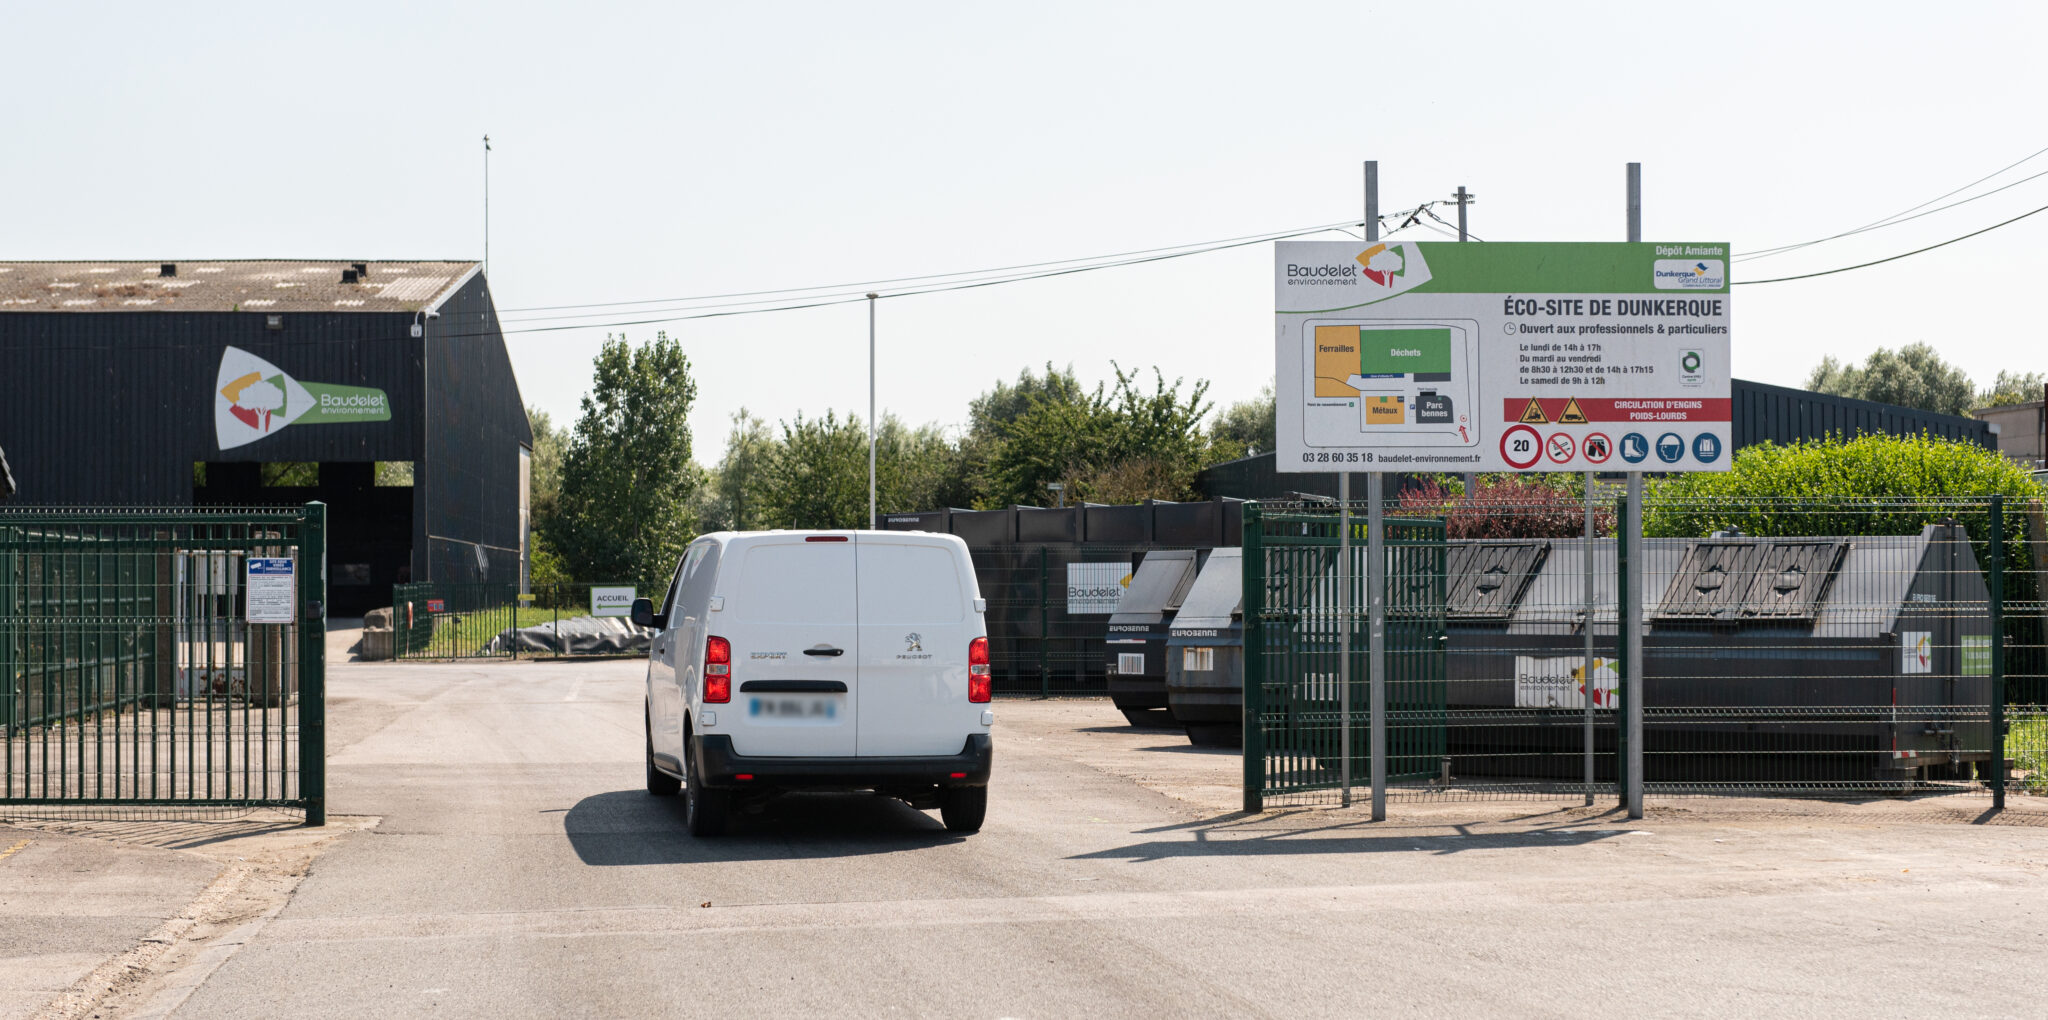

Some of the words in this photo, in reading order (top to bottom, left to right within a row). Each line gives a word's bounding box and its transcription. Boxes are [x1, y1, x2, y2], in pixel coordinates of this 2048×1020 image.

[1656, 246, 1682, 256] Dépôt
[1684, 246, 1723, 255] Amiante
[1288, 264, 1357, 277] Baudelet
[1656, 270, 1696, 278] Dunkerque
[1288, 278, 1357, 286] environnement
[1504, 296, 1583, 316] ÉCO-SITE
[1589, 299, 1612, 316] DE
[1618, 299, 1722, 317] DUNKERQUE
[1520, 324, 1554, 334] Ouvert
[1579, 324, 1654, 336] professionnels
[1657, 324, 1665, 334] &
[1668, 324, 1728, 336] particuliers
[1390, 348, 1421, 356] Déchets
[321, 394, 384, 406] Baudelet
[1513, 440, 1529, 452] 20
[1303, 453, 1314, 462] 03
[1317, 453, 1330, 462] 28
[1332, 453, 1344, 462] 60
[1347, 453, 1358, 462] 35
[1361, 453, 1373, 462] 18
[1378, 454, 1480, 463] baudelet-environnement.fr
[1068, 587, 1120, 597] Baudelet
[1520, 674, 1572, 684] Baudelet
